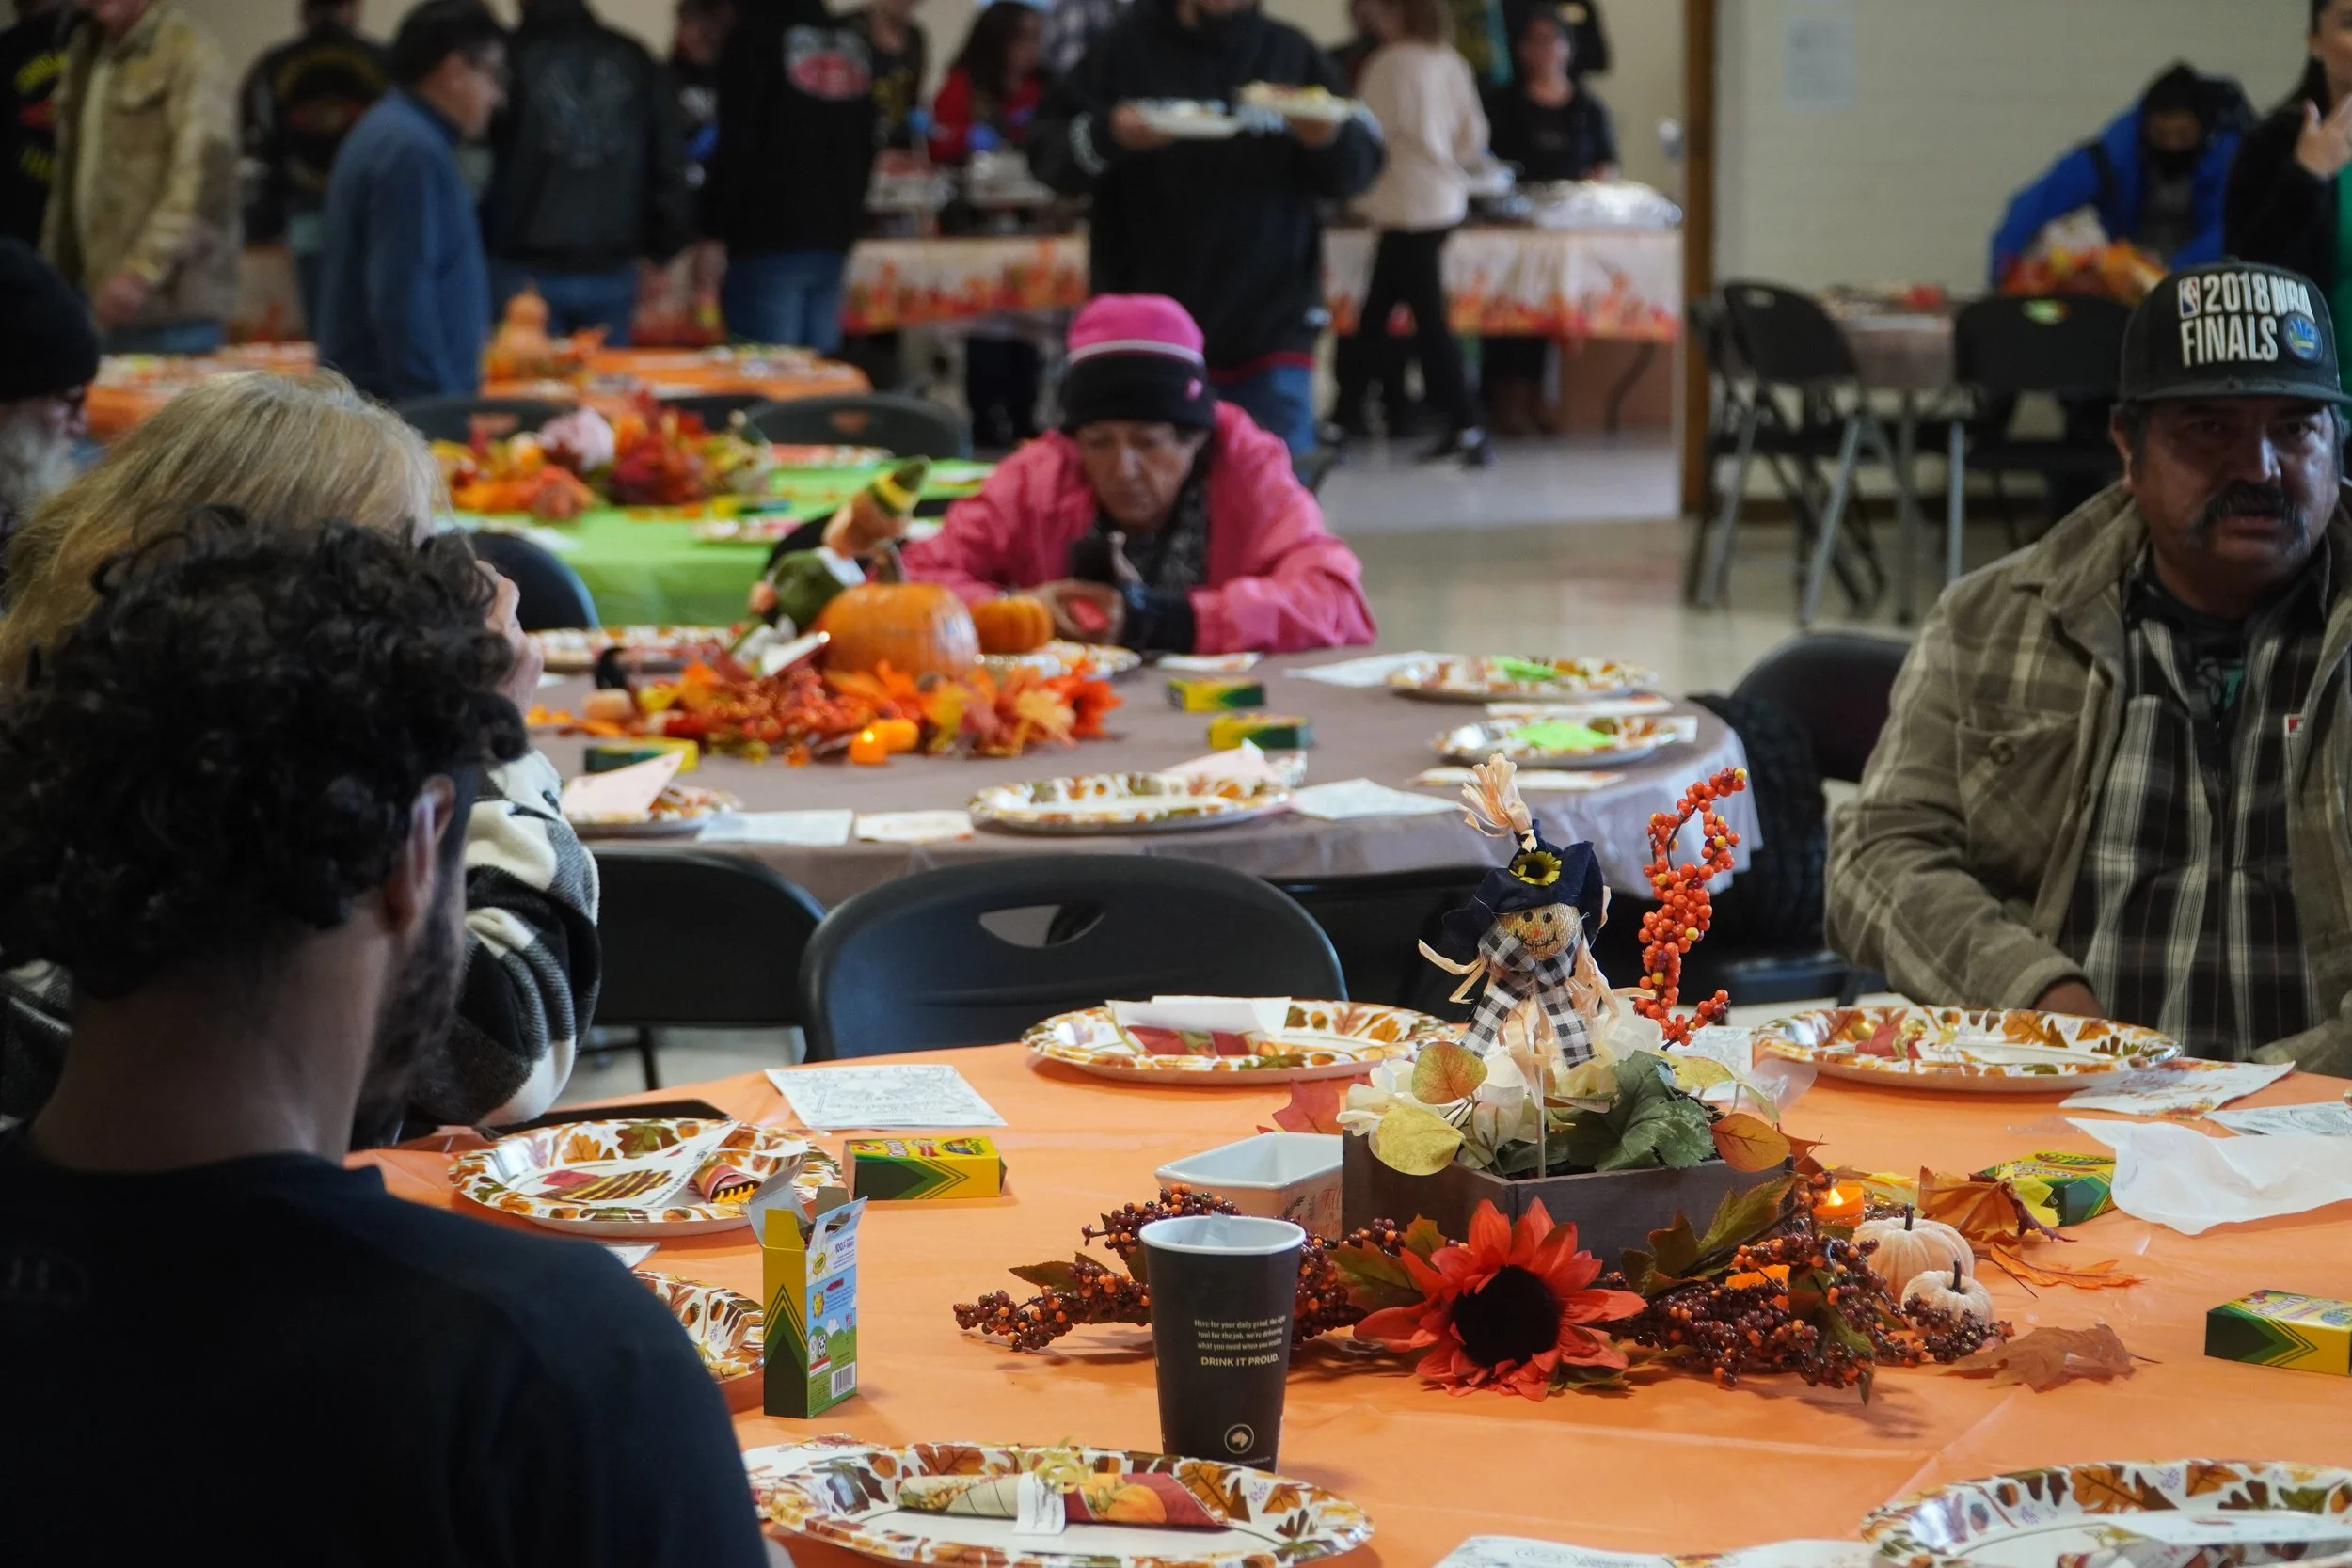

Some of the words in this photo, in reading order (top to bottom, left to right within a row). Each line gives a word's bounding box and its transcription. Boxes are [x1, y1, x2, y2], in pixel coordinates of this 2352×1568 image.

[2203, 271, 2270, 313] 2018
[2268, 274, 2315, 324] NBA
[2180, 314, 2278, 368] FINALS
[1194, 1319, 1209, 1327] Here
[1211, 1320, 1219, 1328] for
[1237, 1320, 1251, 1329] daily
[1200, 1356, 1234, 1367] DRINK
[1236, 1357, 1248, 1366] IT
[1248, 1353, 1279, 1366] PROUD.
